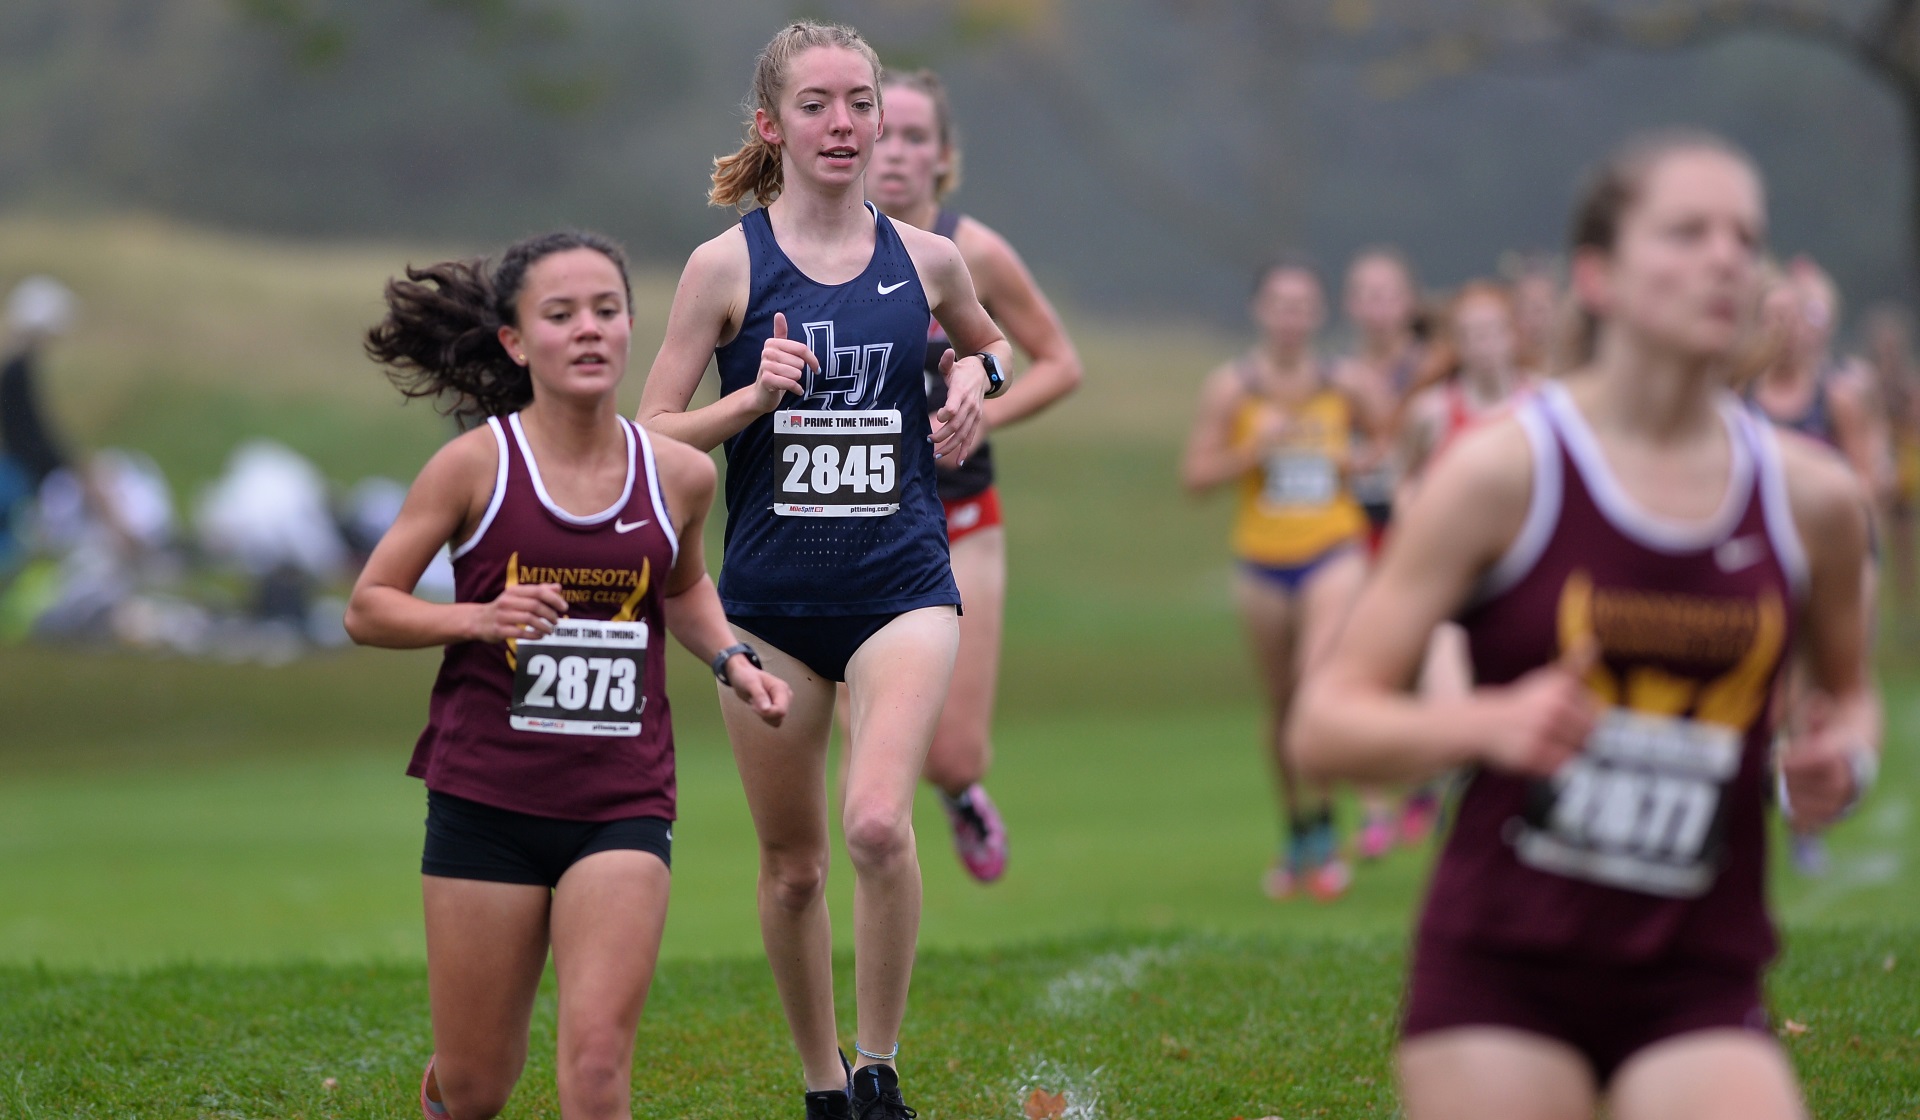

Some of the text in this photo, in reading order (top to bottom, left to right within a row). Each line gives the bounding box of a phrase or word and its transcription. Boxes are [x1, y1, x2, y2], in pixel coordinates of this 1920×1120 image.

[804, 417, 889, 427] PRIME TIME TIMING
[782, 444, 895, 494] 2845
[520, 566, 638, 586] MINNESOTA
[525, 654, 637, 712] 2873
